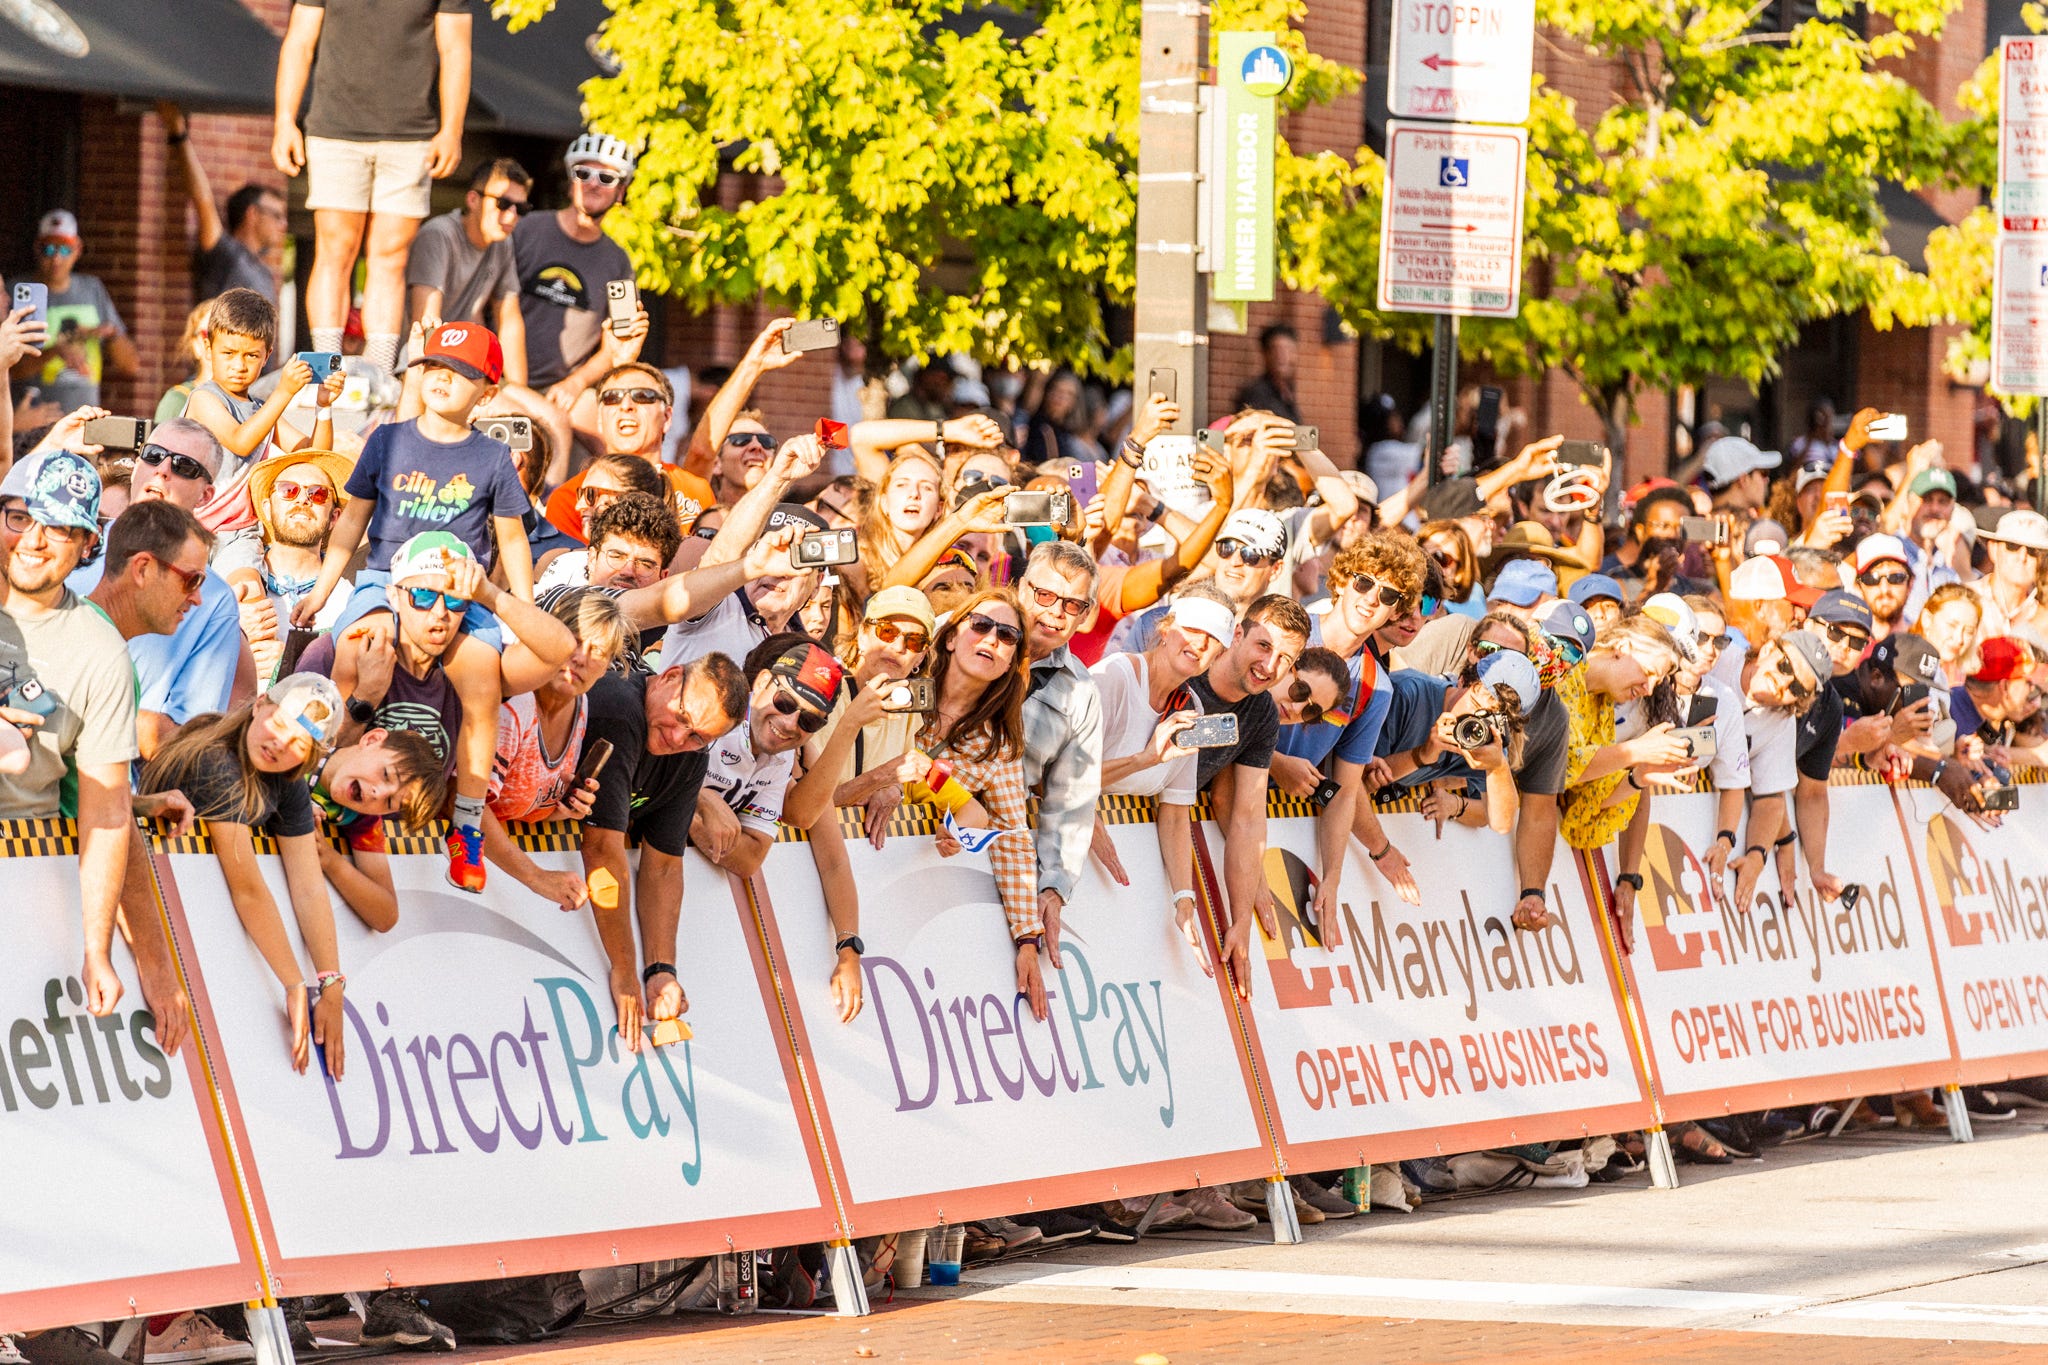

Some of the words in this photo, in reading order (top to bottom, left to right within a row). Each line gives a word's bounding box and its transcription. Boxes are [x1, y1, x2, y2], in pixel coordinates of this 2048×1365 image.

[1408, 3, 1503, 35] STOPPIN
[1236, 112, 1258, 214] HARBOR
[1413, 136, 1469, 153] Parking
[1235, 217, 1256, 291] INNER
[1397, 253, 1440, 266] OTHER
[1443, 257, 1500, 270] VEHICLES
[1406, 267, 1454, 281] TOWED
[1457, 271, 1494, 283] AWAY
[393, 471, 437, 503] city
[397, 496, 460, 524] rider
[706, 769, 732, 786] MARKETS
[1718, 856, 1909, 982] Maryland
[1342, 884, 1584, 1021] Maryland
[859, 941, 1175, 1129] DirectPay
[1671, 1003, 1751, 1064] OPEN
[1752, 996, 1808, 1054] FOR
[1807, 984, 1926, 1048] BUSINESS
[1963, 977, 2024, 1031] OPEN
[2022, 974, 2048, 1026] FO
[306, 977, 702, 1187] DirectPay
[1296, 1044, 1389, 1111] OPEN
[1389, 1037, 1462, 1100] FOR
[1460, 1022, 1609, 1092] BUSINESS
